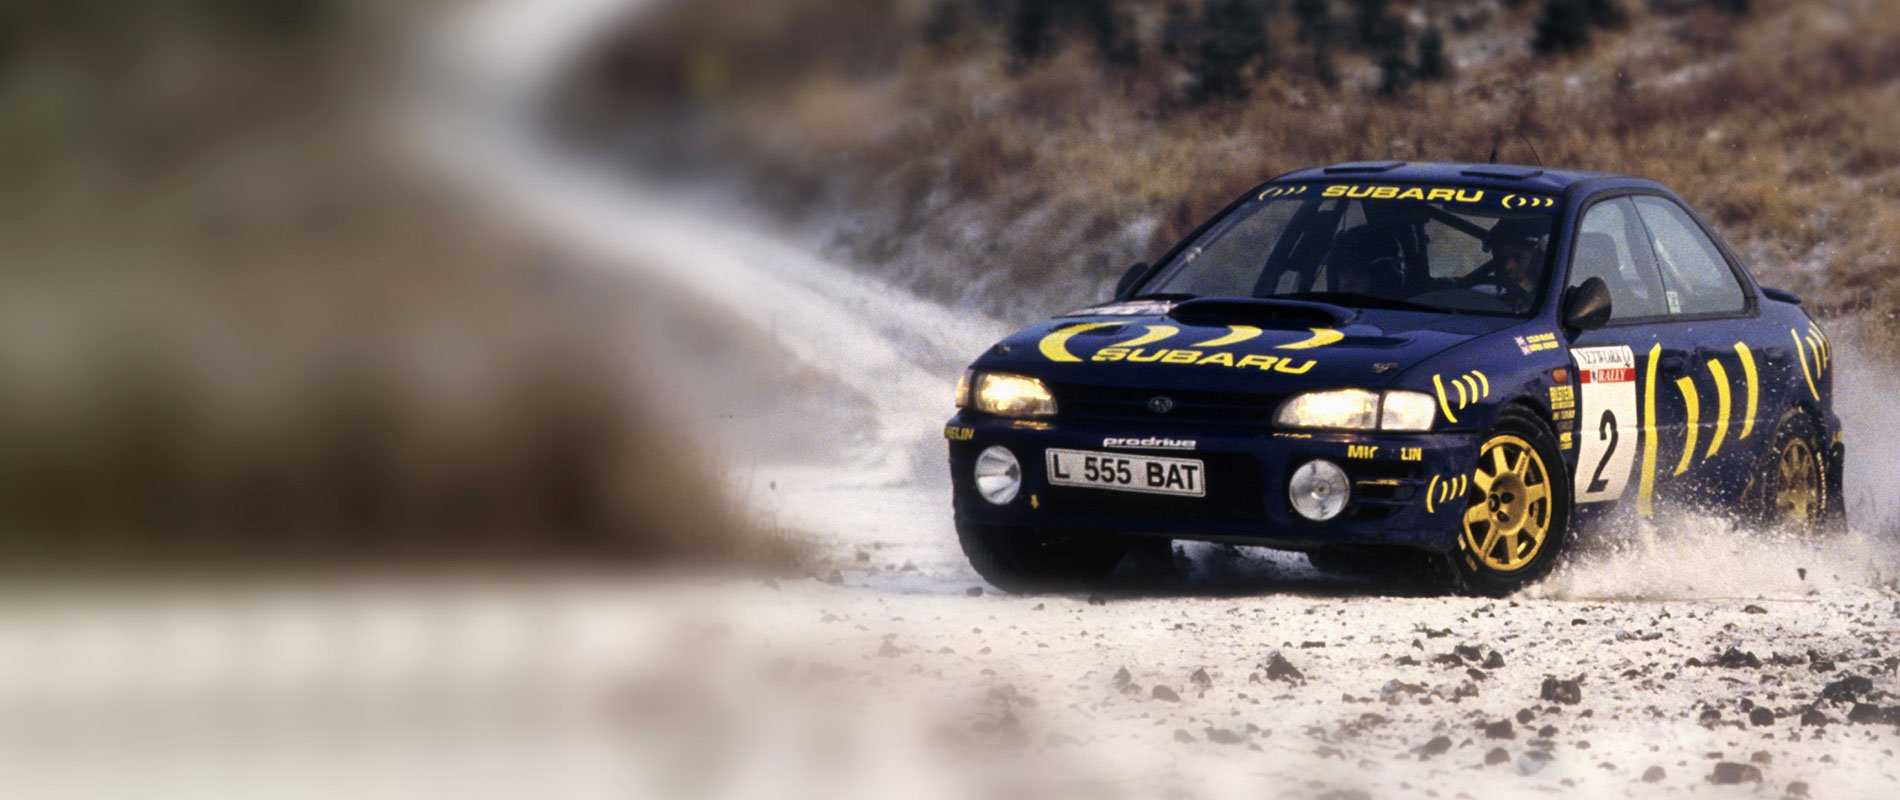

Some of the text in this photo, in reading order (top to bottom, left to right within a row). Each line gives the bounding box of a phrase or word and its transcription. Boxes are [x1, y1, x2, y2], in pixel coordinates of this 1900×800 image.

[1321, 185, 1484, 203] SUBARU
[1091, 348, 1317, 374] SUBARU
[1598, 369, 1626, 382] RALLY
[1103, 437, 1196, 448] prodrive
[1586, 409, 1619, 493] 2
[1347, 445, 1422, 461] MICLIN
[1053, 454, 1198, 490] L 555 BAT
